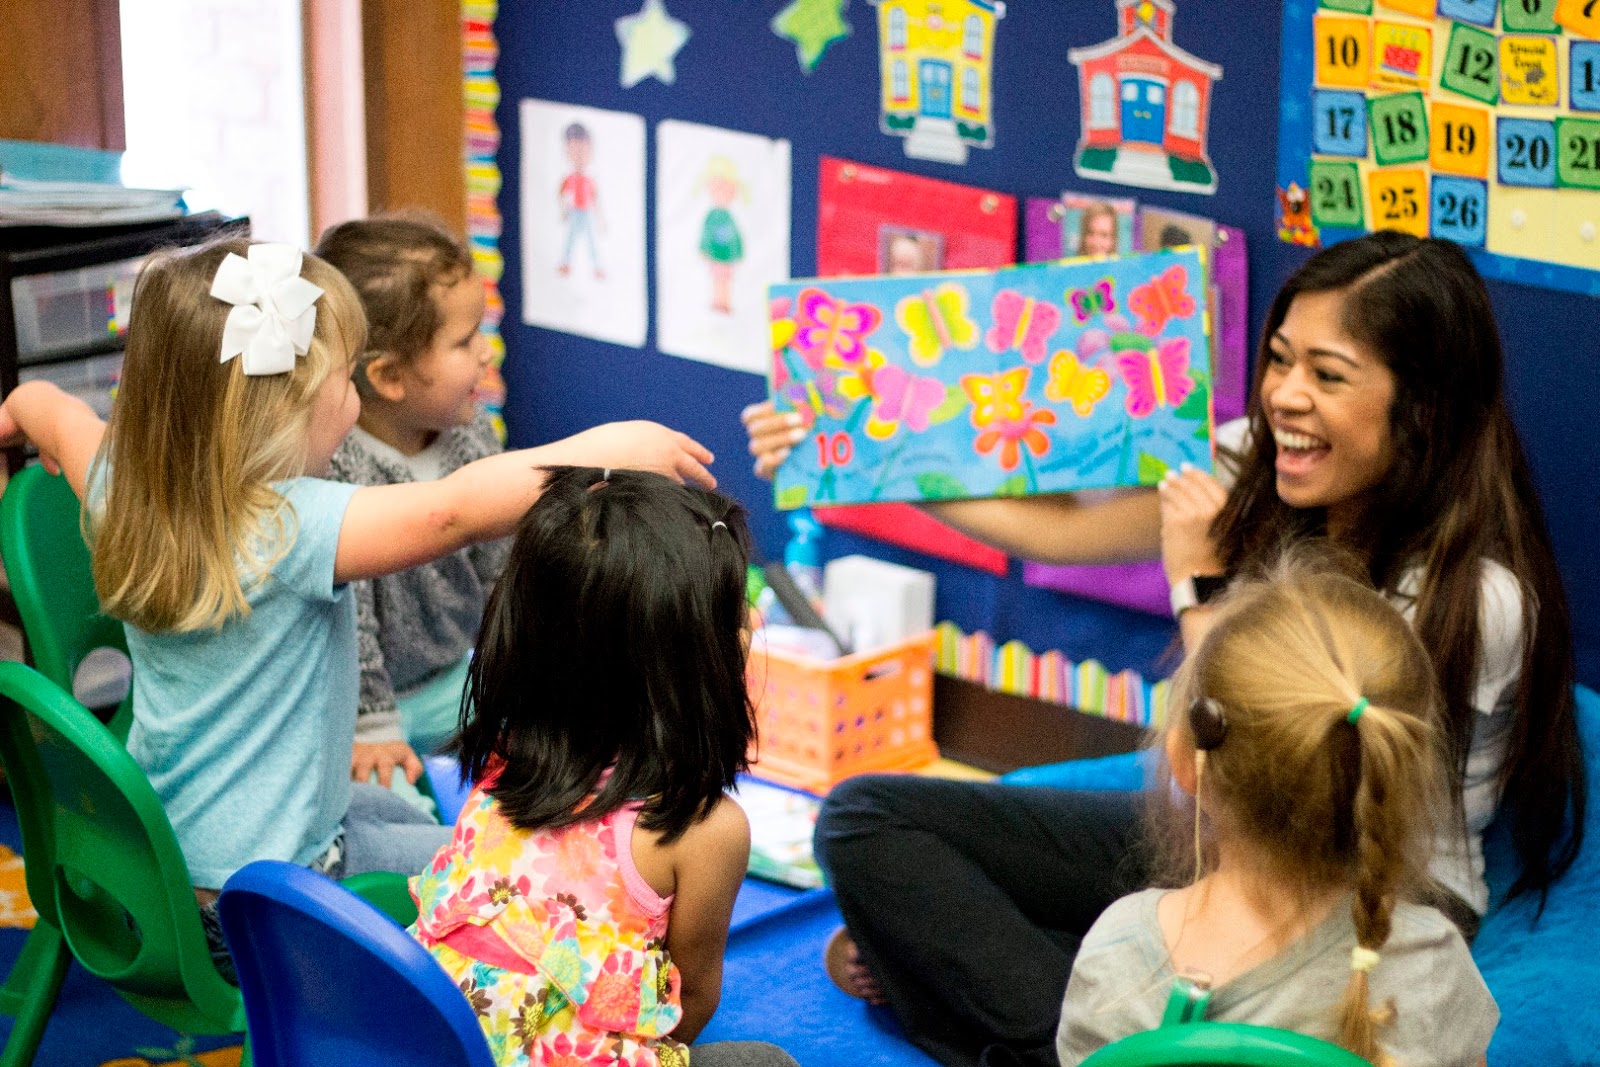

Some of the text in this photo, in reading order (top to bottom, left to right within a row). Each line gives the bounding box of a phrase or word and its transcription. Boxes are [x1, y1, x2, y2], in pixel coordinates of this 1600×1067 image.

[1327, 36, 1359, 67] 10
[1456, 44, 1494, 85] 12
[1580, 59, 1600, 93] 1
[1326, 107, 1355, 140] 17
[1383, 111, 1417, 145] 18
[1444, 121, 1476, 155] 19
[1506, 134, 1550, 171] 20
[1318, 177, 1355, 210] 24
[1381, 188, 1418, 219] 25
[1439, 193, 1478, 228] 26
[816, 431, 853, 468] 10
